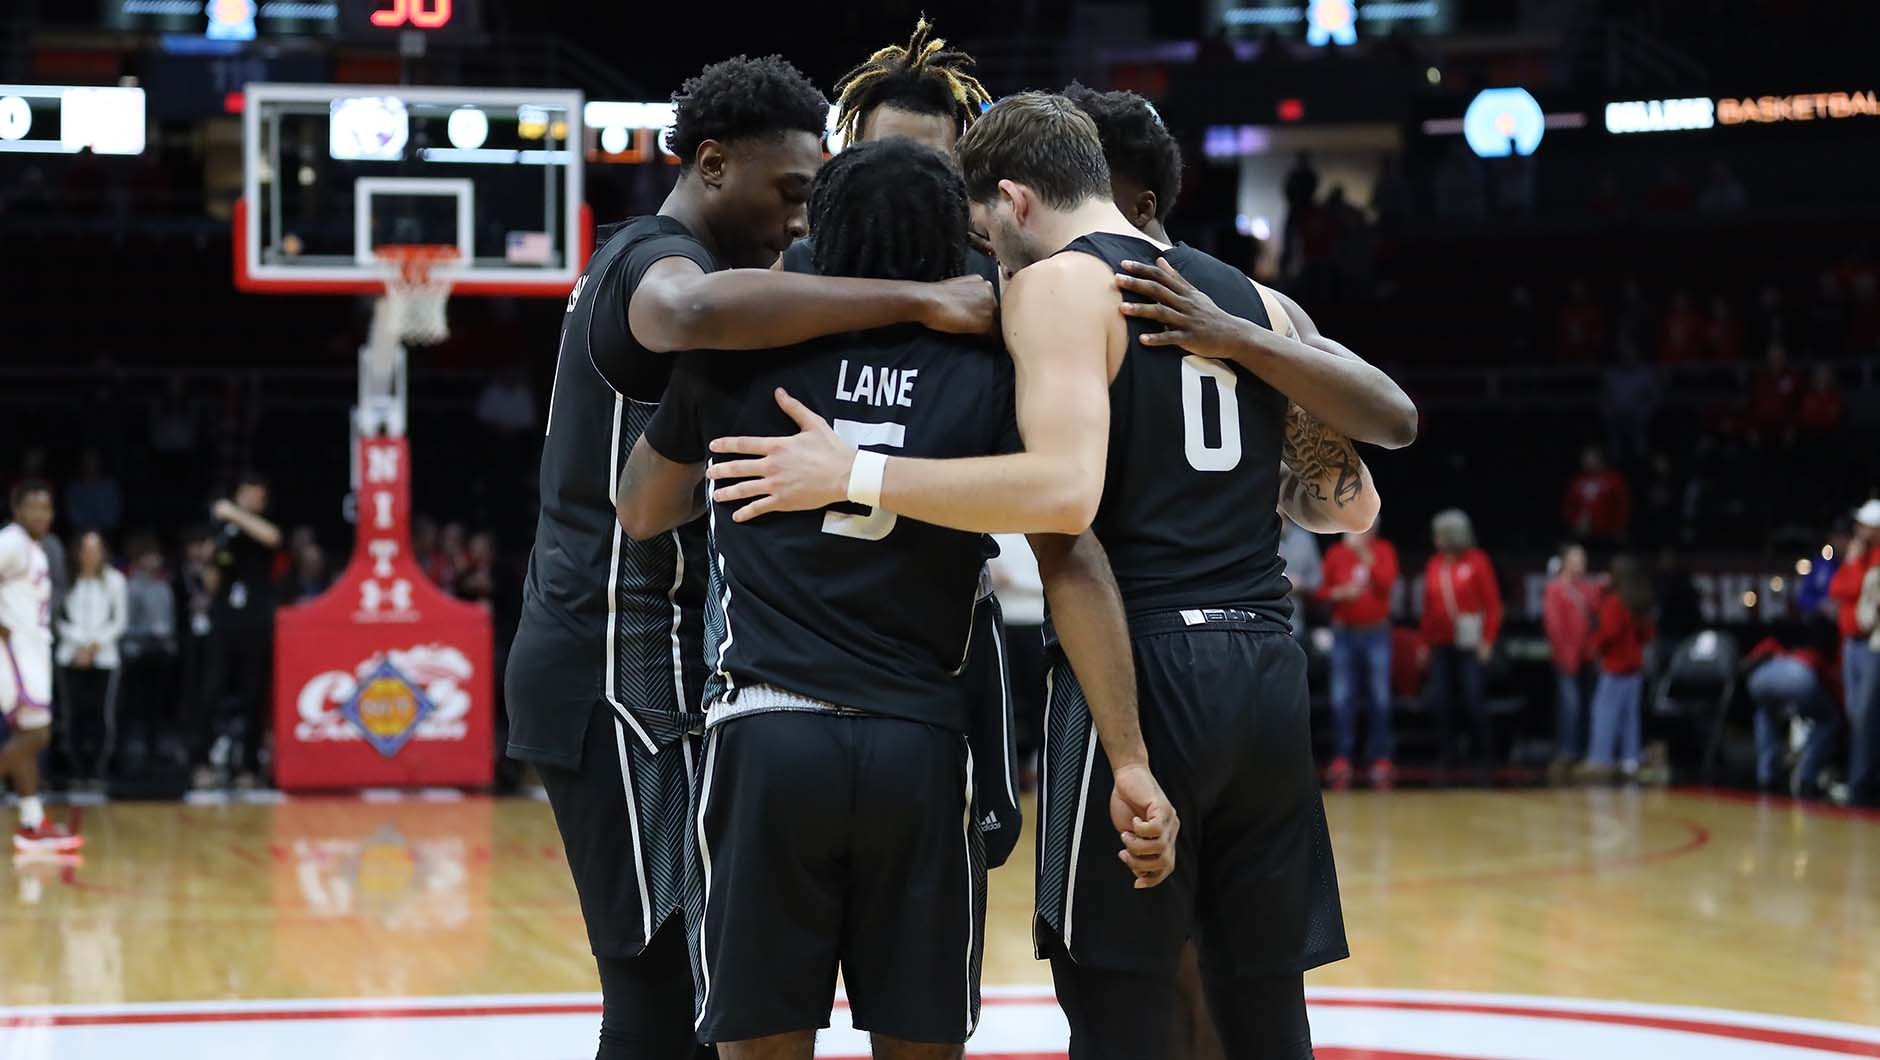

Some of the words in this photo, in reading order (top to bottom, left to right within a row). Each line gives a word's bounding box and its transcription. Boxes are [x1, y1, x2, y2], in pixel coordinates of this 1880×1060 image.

[835, 359, 919, 408] LANE
[1181, 354, 1242, 472] 0
[367, 445, 400, 578] NIT
[821, 418, 906, 541] 5
